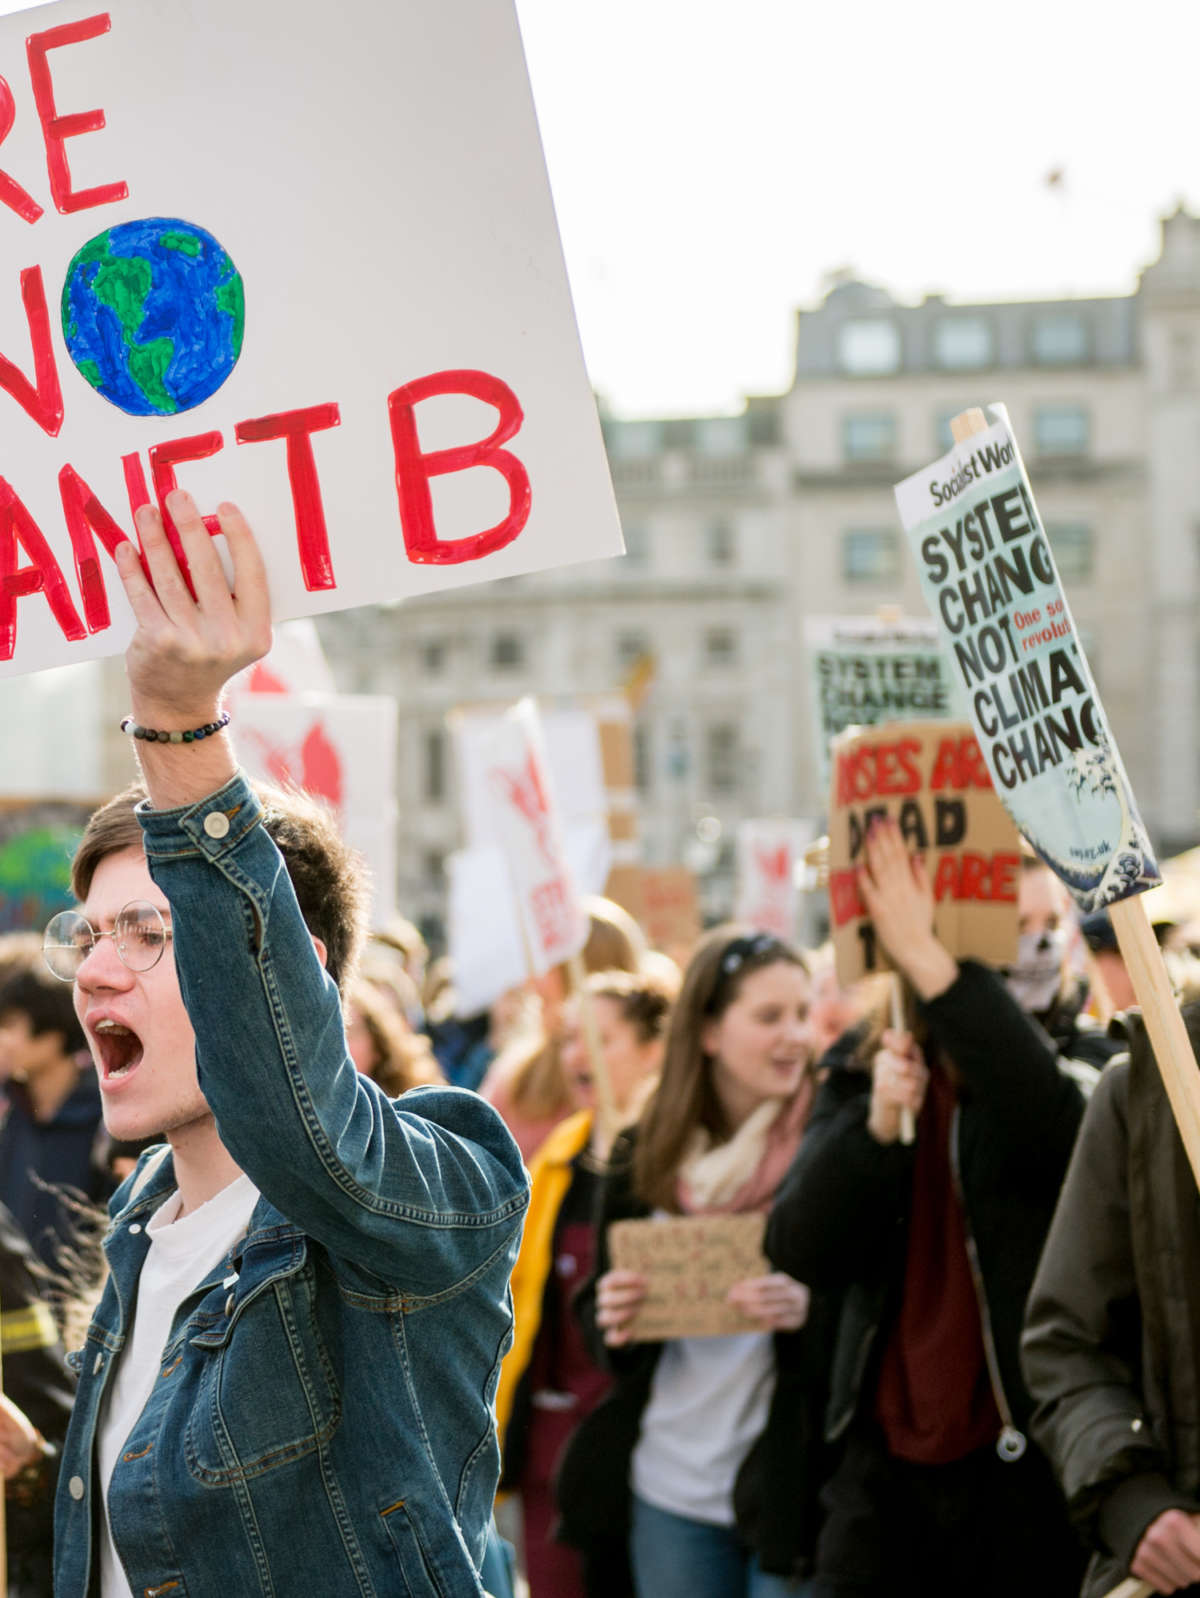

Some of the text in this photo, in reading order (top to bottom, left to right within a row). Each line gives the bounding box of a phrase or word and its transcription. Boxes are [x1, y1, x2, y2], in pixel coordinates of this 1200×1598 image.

[388, 368, 534, 565] B
[953, 614, 1019, 688] NOT
[1013, 608, 1041, 630] One
[818, 655, 941, 680] SYSTEM
[974, 643, 1087, 738] CLIMA
[933, 851, 1021, 905] ARE
